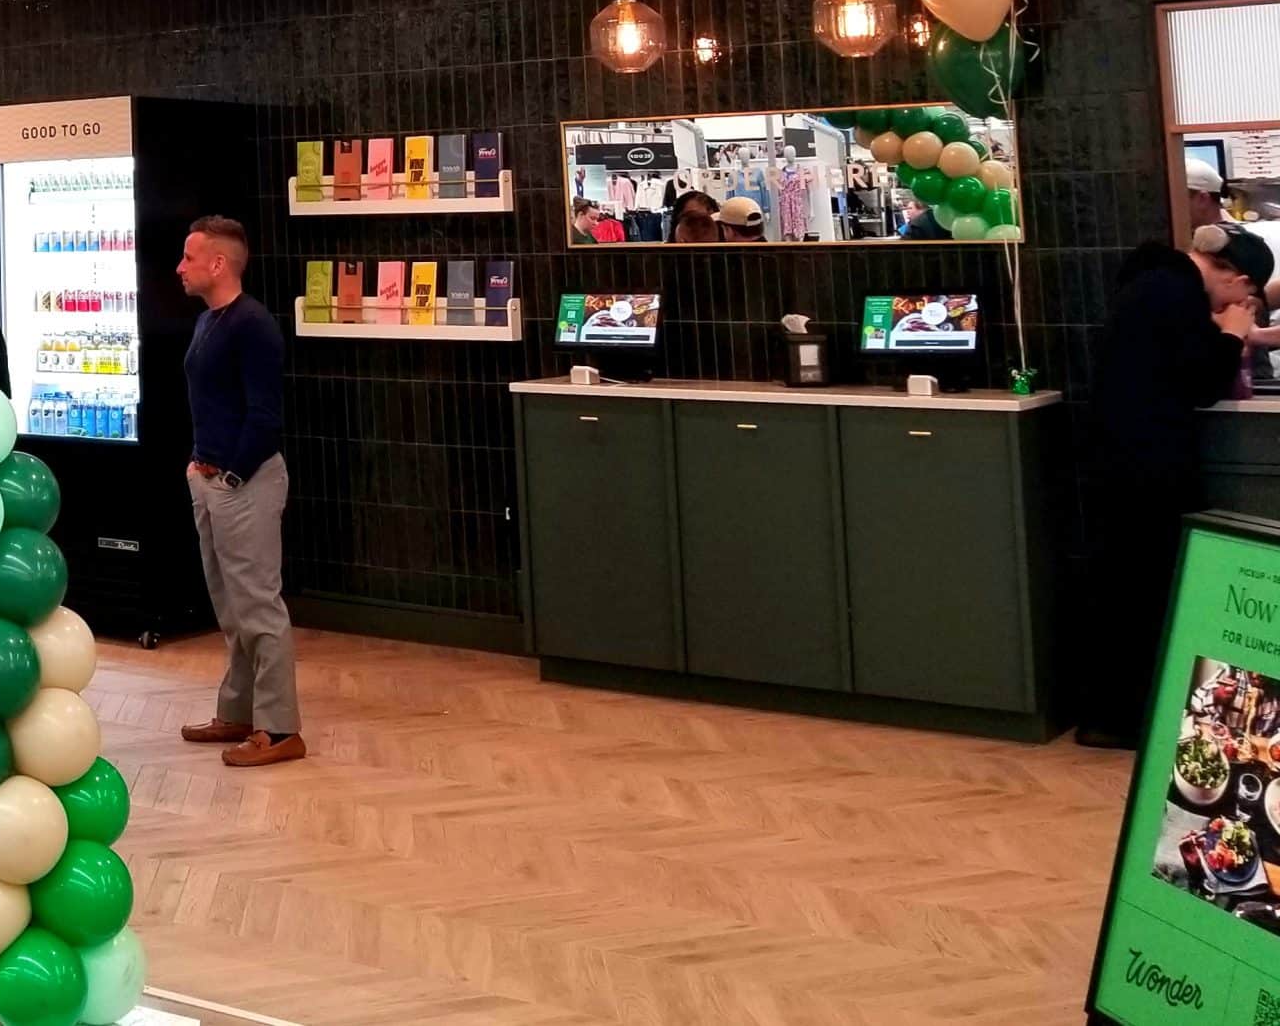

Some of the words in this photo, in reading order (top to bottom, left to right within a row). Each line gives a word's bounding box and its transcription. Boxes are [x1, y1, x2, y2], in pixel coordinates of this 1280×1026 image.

[22, 126, 57, 140] GOOD
[61, 124, 78, 137] TO
[82, 122, 101, 136] GO
[1224, 584, 1278, 624] Now
[1222, 629, 1242, 646] FOR
[1245, 636, 1280, 656] LUNCH
[1126, 947, 1204, 1010] Wonder
